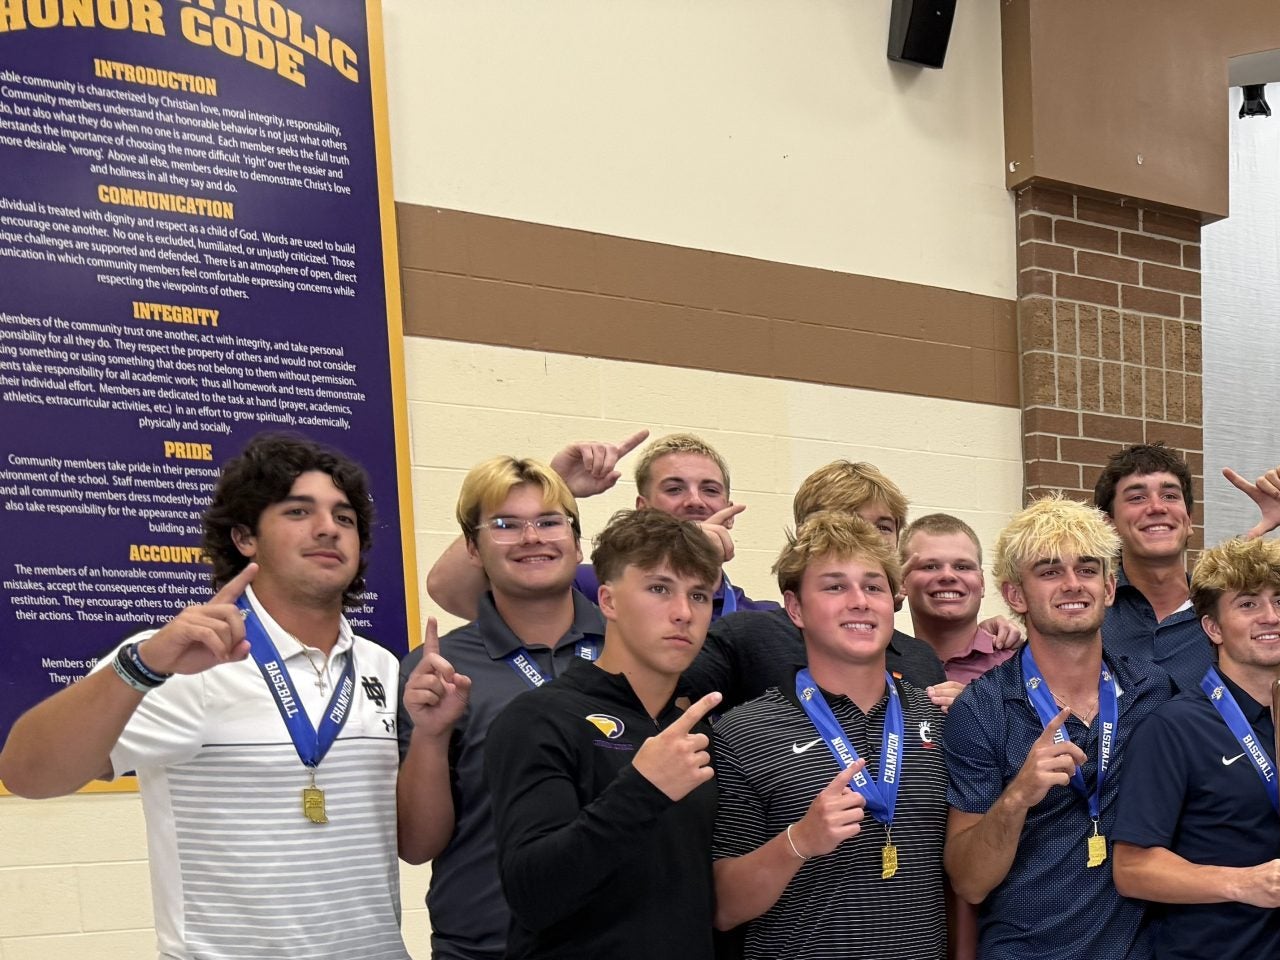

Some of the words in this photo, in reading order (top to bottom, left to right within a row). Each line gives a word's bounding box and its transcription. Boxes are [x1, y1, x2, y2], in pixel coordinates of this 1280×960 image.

[180, 6, 306, 88] CODE
[181, 0, 359, 83] HOLIC
[93, 58, 218, 97] INTRODUCTION
[1, 86, 57, 107] Community
[58, 97, 102, 112] members
[102, 104, 155, 120] understand
[155, 110, 174, 124] that
[174, 112, 220, 131] honorable
[220, 120, 258, 136] behavior
[258, 126, 267, 138] is
[267, 130, 282, 141] not
[283, 130, 299, 144] just
[299, 134, 321, 147] what
[321, 137, 348, 151] others
[22, 76, 76, 94] community
[77, 82, 85, 93] is
[86, 84, 147, 104] characterized
[147, 93, 160, 108] by
[160, 96, 200, 112] Christian
[200, 102, 221, 117] love,
[222, 108, 247, 120] moral
[247, 110, 285, 128] integrity,
[286, 118, 342, 137] responsibility,
[90, 163, 108, 175] and
[109, 164, 146, 180] holiness
[147, 170, 156, 181] in
[157, 172, 168, 183] all
[169, 173, 189, 188] they
[190, 178, 205, 191] say
[206, 180, 223, 191] and
[223, 181, 238, 193] do.
[97, 184, 235, 219] COMMUNICATION
[0, 215, 51, 232] encourage
[51, 222, 70, 233] one
[71, 224, 110, 238] another.
[112, 227, 127, 240] No
[127, 231, 145, 242] one
[146, 231, 154, 243] is
[154, 234, 197, 250] excluded,
[197, 237, 245, 255] humiliated,
[245, 246, 255, 256] or
[256, 247, 290, 262] unjustly
[290, 252, 329, 265] criticized.
[330, 255, 355, 269] Those
[96, 274, 144, 290] respecting
[145, 276, 161, 289] the
[161, 279, 209, 295] viewpoints
[209, 284, 219, 295] of
[219, 286, 249, 299] others.
[133, 301, 219, 327] INTEGRITY
[3, 390, 45, 405] athletics,
[45, 395, 110, 409] extracurricular
[111, 399, 153, 413] activities,
[153, 403, 172, 415] etc.)
[175, 404, 185, 415] in
[185, 407, 197, 416] an
[197, 405, 222, 418] effort
[222, 409, 232, 419] to
[233, 411, 255, 422] grow
[255, 411, 297, 426] spiritually,
[298, 415, 351, 430] academically,
[138, 416, 181, 431] physically
[182, 420, 199, 431] and
[200, 422, 233, 435] socially.
[164, 441, 213, 460] PRIDE
[8, 453, 63, 470] Community
[63, 458, 107, 470] members
[107, 460, 127, 472] take
[128, 462, 152, 474] pride
[152, 463, 162, 474] in
[162, 463, 183, 475] their
[184, 467, 221, 478] personal
[0, 484, 18, 496] and
[19, 485, 31, 496] all
[31, 488, 84, 501] community
[85, 489, 127, 502] members
[128, 491, 152, 503] dress
[152, 493, 193, 507] modestly
[193, 494, 213, 506] both
[5, 499, 24, 511] also
[25, 501, 46, 512] take
[46, 503, 107, 517] responsibility
[107, 504, 120, 516] for
[121, 505, 137, 517] the
[138, 508, 189, 520] appearance
[148, 521, 185, 536] building
[130, 544, 207, 564] ACCOUNT
[14, 563, 33, 575] The
[34, 565, 77, 577] members
[78, 565, 88, 577] of
[89, 568, 101, 577] an
[101, 566, 147, 579] honorable
[148, 570, 197, 582] community
[3, 579, 46, 591] mistakes,
[46, 581, 77, 593] accept
[77, 580, 94, 592] the
[94, 583, 157, 595] consequences
[157, 583, 167, 594] of
[167, 583, 189, 594] their
[10, 594, 61, 606] restitution.
[62, 595, 85, 609] They
[86, 598, 134, 610] encourage
[134, 597, 163, 608] others
[163, 599, 174, 609] to
[174, 598, 188, 609] do
[363, 604, 374, 614] for
[15, 609, 38, 620] their
[38, 610, 74, 621] actions.
[76, 610, 104, 622] Those
[104, 611, 114, 622] in
[115, 611, 155, 625] authority
[42, 658, 84, 669] Members
[513, 654, 545, 688] BASEBA
[48, 672, 71, 687] They
[264, 662, 298, 719] BASEBALL
[329, 676, 353, 725] CHAMPION
[883, 732, 899, 784] CHAMPION
[1101, 721, 1113, 771] BASEBALL
[1242, 733, 1274, 782] BASEBALL
[830, 736, 867, 787] CHMPION
